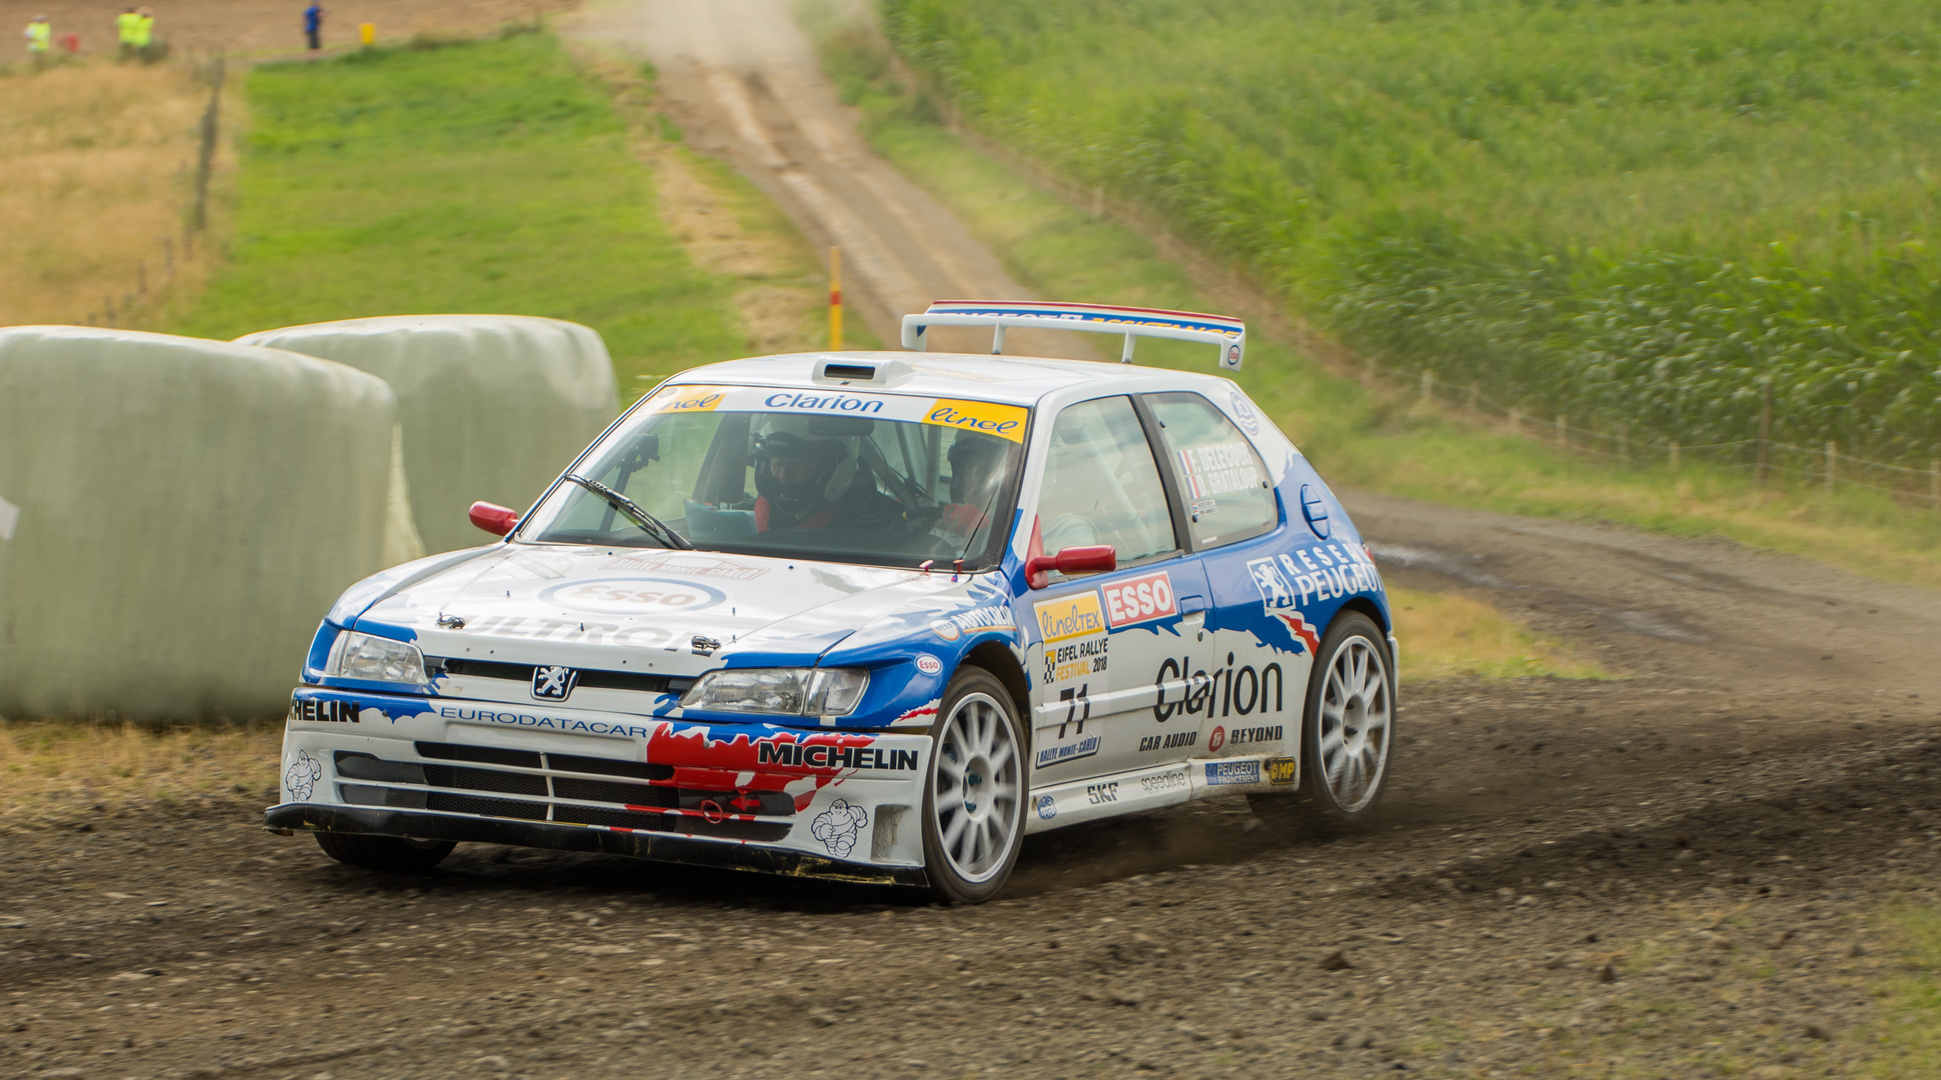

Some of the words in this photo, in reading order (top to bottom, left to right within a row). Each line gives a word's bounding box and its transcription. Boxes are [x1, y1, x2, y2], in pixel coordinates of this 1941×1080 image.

[765, 393, 883, 413] Clarion
[930, 407, 1018, 434] linel
[1294, 562, 1383, 606] PEUGEOT
[1107, 578, 1171, 622] ESSO
[1057, 643, 1079, 664] EIFEL
[1080, 637, 1108, 659] RALLYE
[1055, 661, 1091, 682] FESTIVAL
[1093, 656, 1108, 673] 2018
[1152, 652, 1284, 723] Clarion
[440, 707, 648, 738] EURODATACAR
[1059, 683, 1089, 740] 71
[1138, 737, 1162, 752] CAR
[1163, 731, 1198, 749] AUDIO
[1230, 725, 1283, 744] BEYOND
[758, 742, 919, 771] MICHELIN
[1039, 747, 1058, 762] RALLYE
[1217, 762, 1258, 776] PEUGEOT
[1270, 762, 1295, 780] OMP
[1087, 782, 1118, 805] SKF
